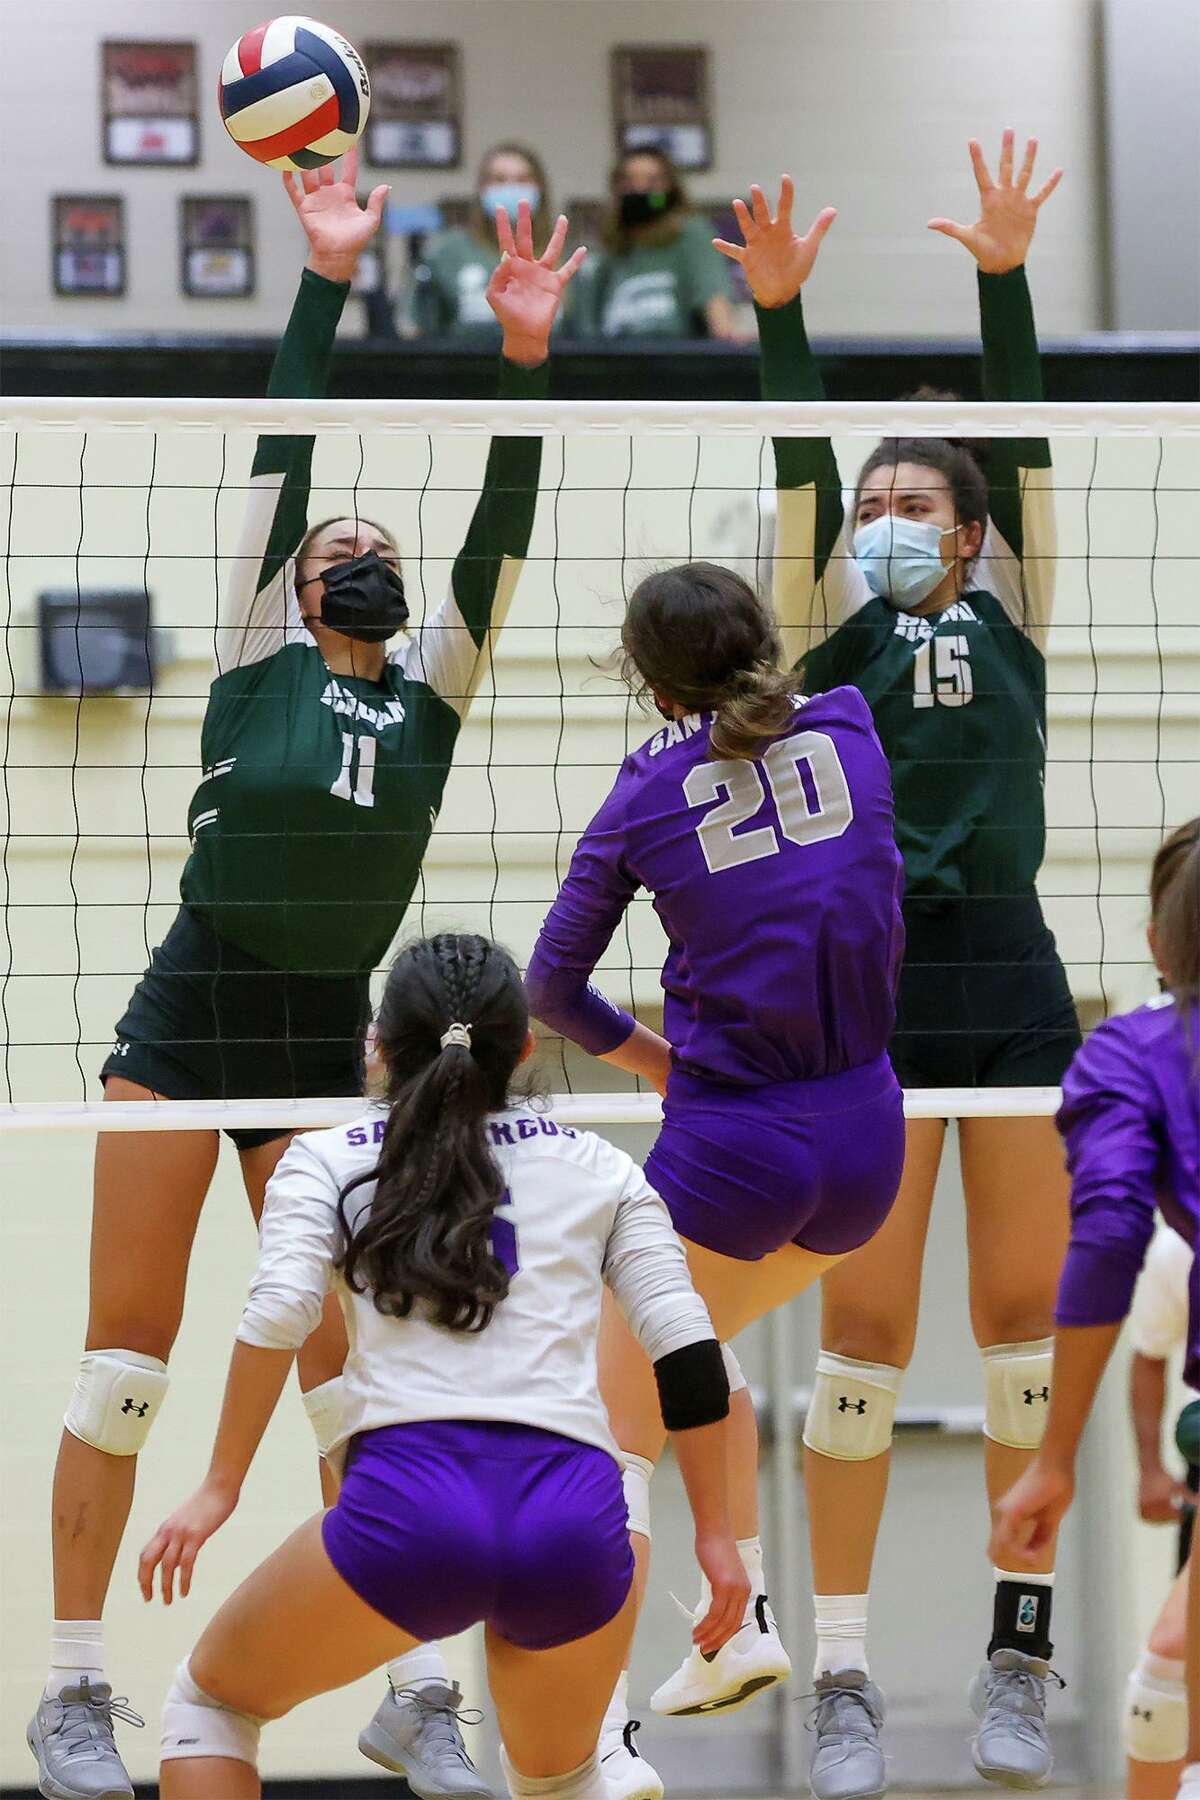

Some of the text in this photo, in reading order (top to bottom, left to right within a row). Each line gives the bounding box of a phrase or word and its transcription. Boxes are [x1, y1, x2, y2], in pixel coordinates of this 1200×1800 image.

[912, 635, 973, 709] 15
[330, 732, 377, 808] 11
[649, 713, 702, 757] SAN
[682, 730, 854, 874] 20
[346, 1120, 388, 1147] SA
